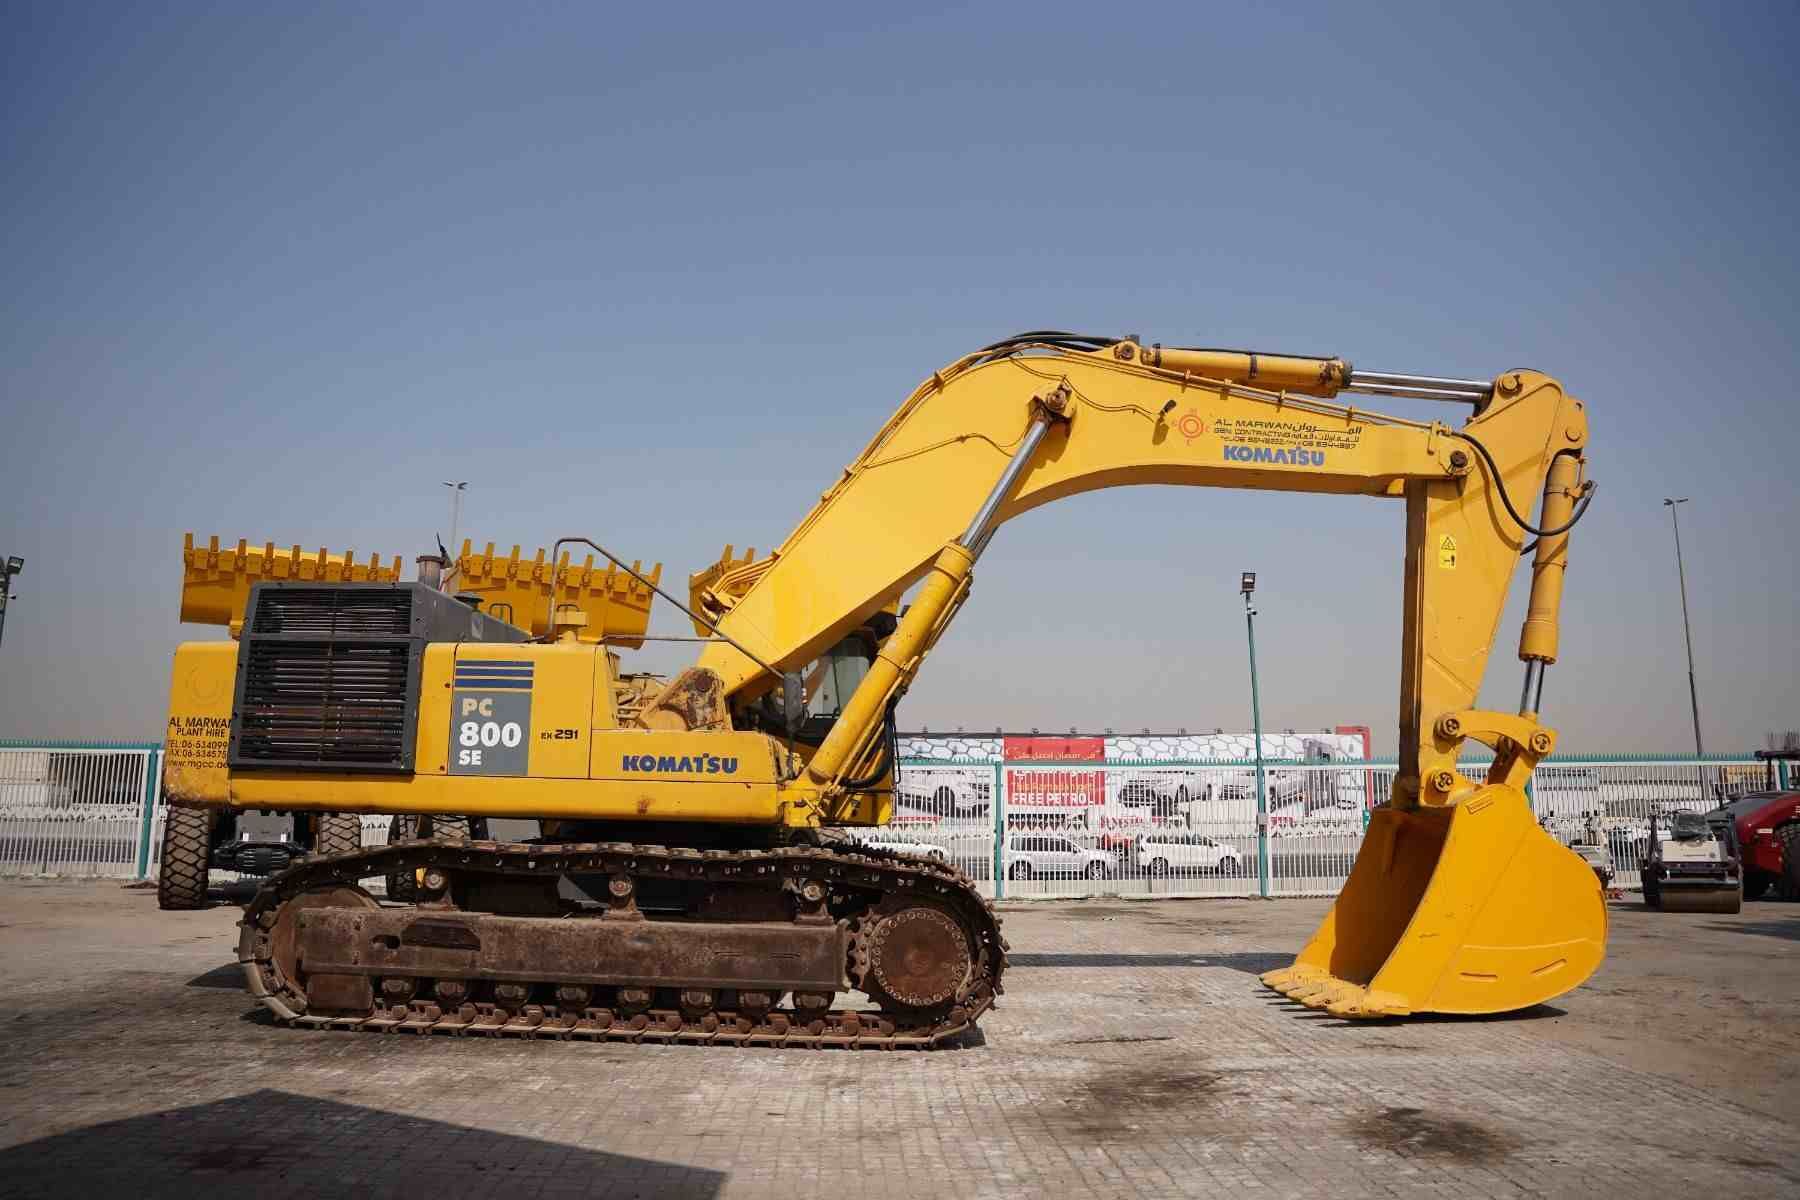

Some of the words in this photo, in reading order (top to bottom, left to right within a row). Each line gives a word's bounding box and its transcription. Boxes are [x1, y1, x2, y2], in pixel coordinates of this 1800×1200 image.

[1215, 418, 1232, 426] AL
[1235, 420, 1293, 430] MARWAN
[1223, 445, 1325, 466] KOMATSU
[461, 697, 493, 717] PC
[168, 716, 182, 728] AL
[176, 727, 204, 737] PLANT
[205, 728, 225, 738] HIRE
[459, 721, 522, 748] 800
[540, 731, 553, 740] EX
[554, 729, 579, 740] 291
[458, 749, 482, 766] SE
[622, 753, 738, 774] KOMATSU
[1012, 792, 1044, 805] FREE
[1046, 793, 1094, 807] PETROL
